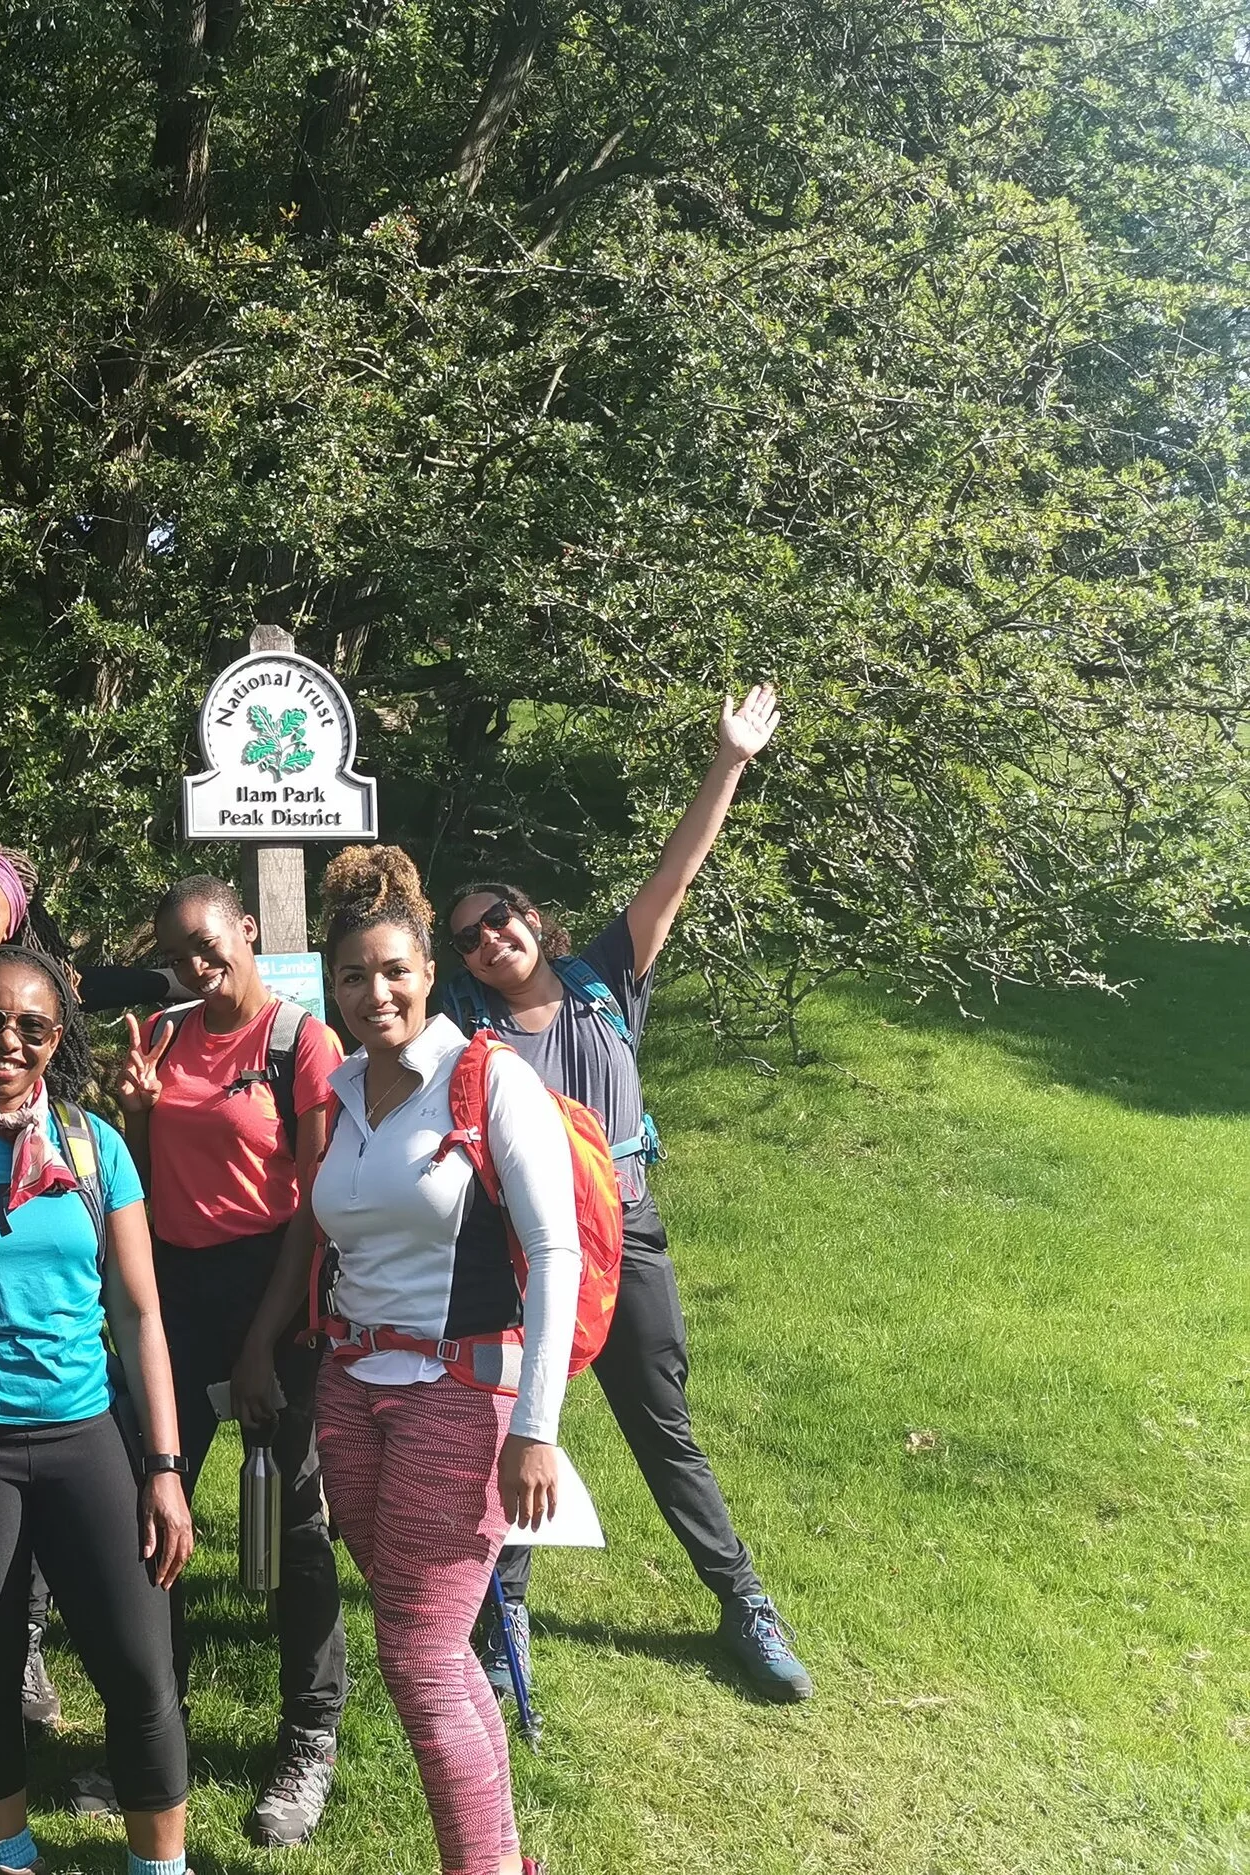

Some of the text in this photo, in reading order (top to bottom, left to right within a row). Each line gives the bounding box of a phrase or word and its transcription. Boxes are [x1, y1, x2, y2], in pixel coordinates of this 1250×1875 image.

[214, 670, 335, 728] National Trust
[236, 786, 326, 803] Ilam Park
[219, 808, 342, 827] Peak District
[271, 960, 316, 975] Lambs
